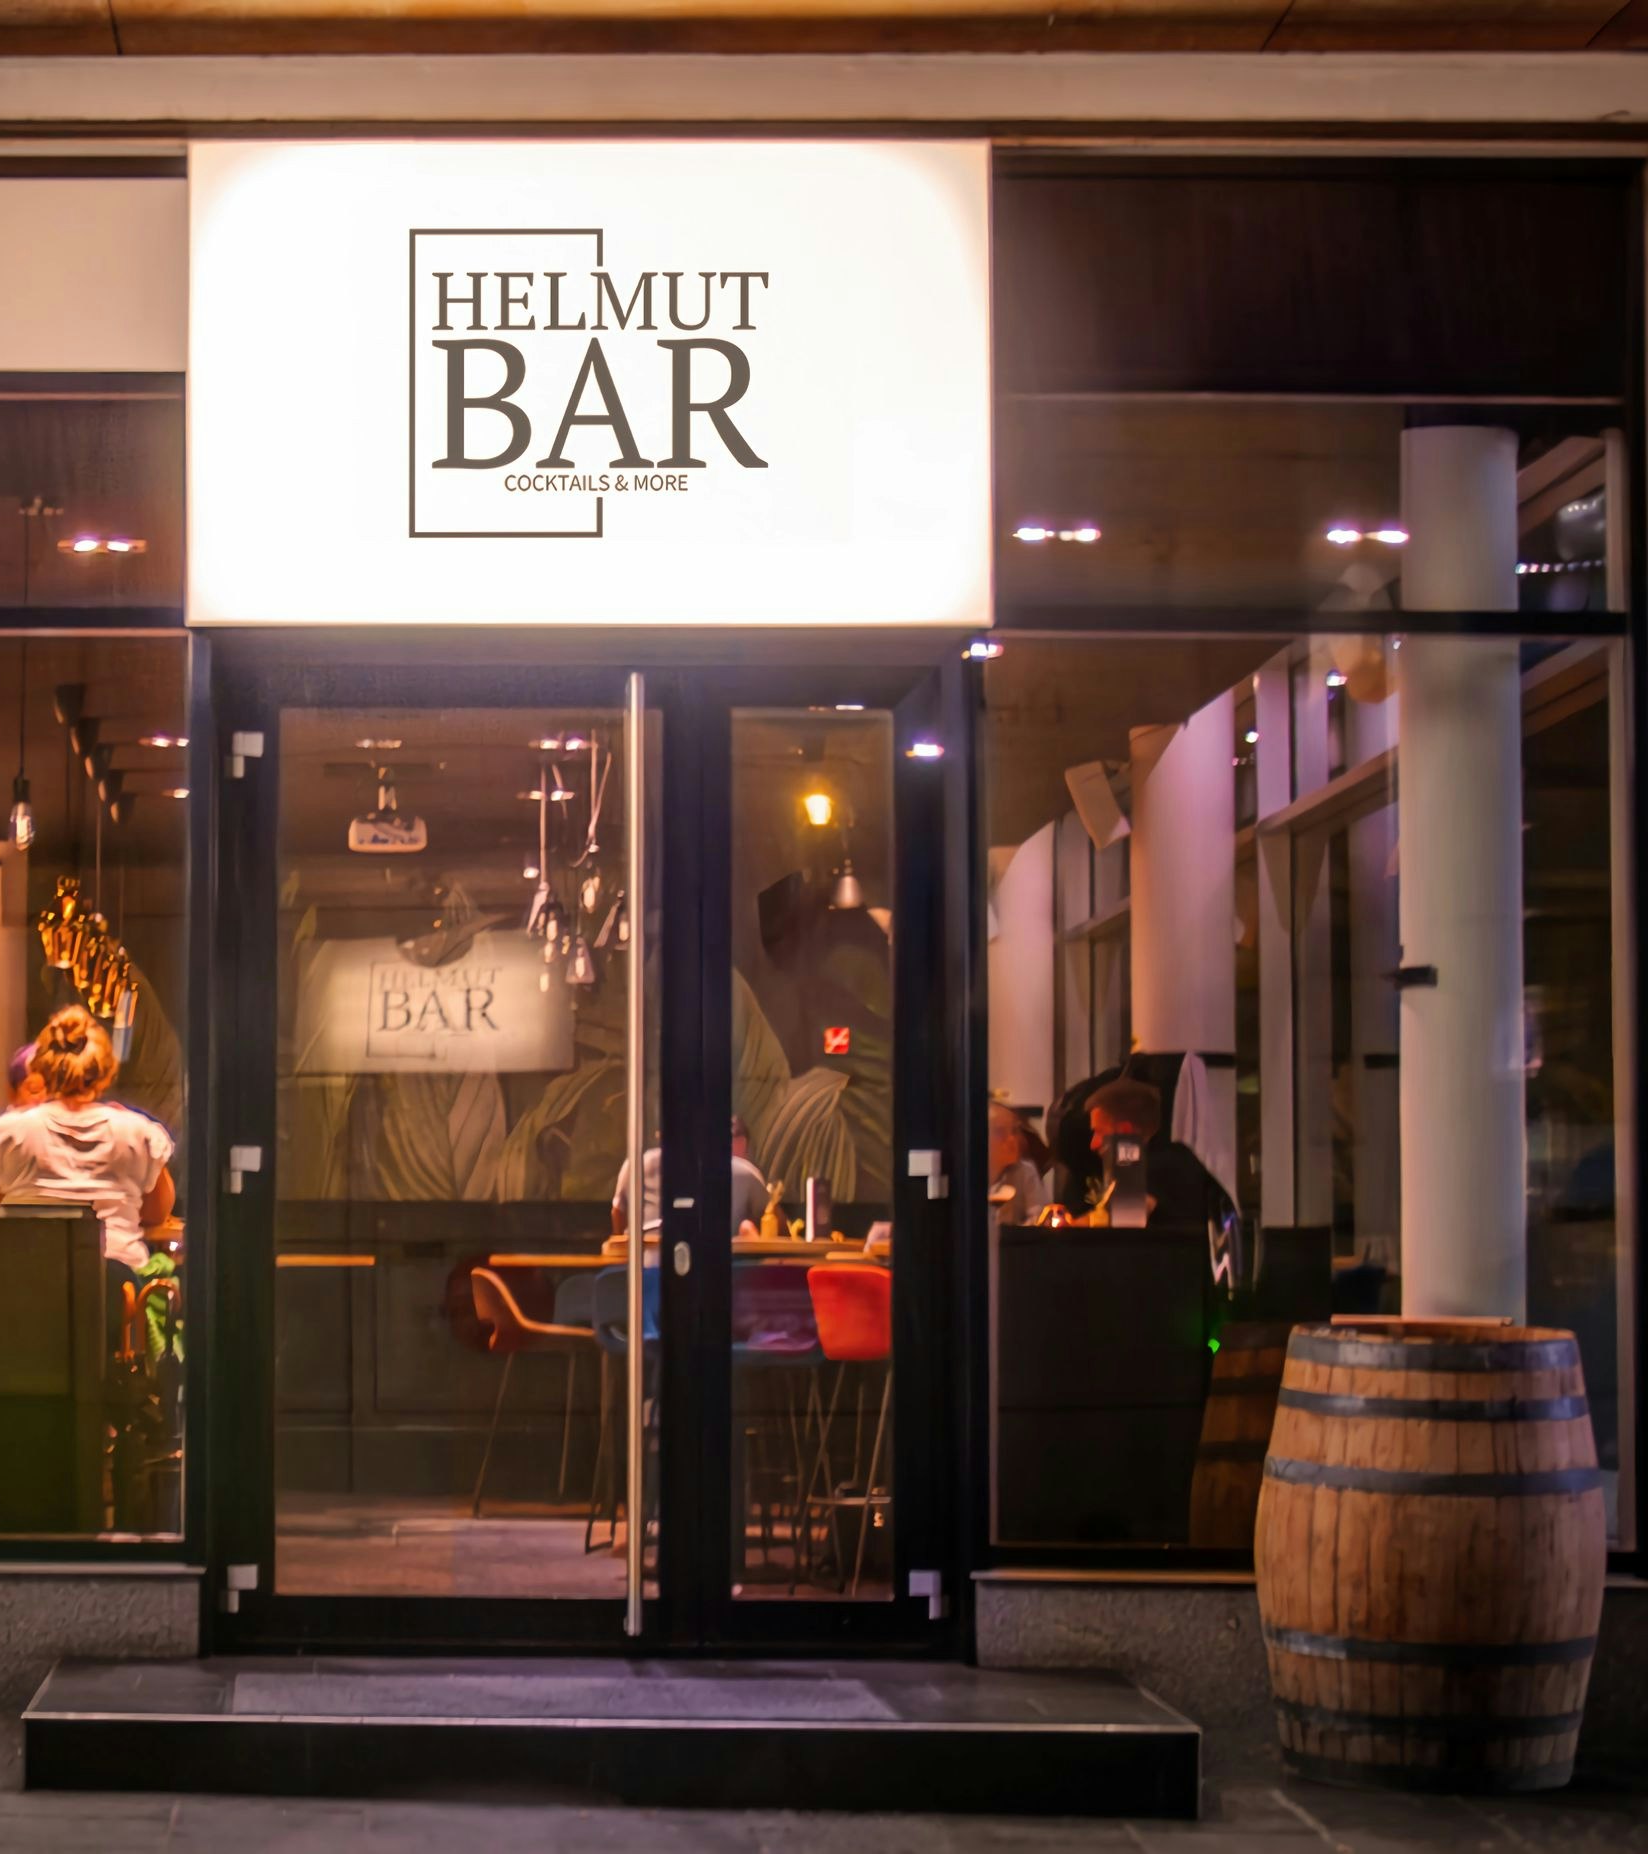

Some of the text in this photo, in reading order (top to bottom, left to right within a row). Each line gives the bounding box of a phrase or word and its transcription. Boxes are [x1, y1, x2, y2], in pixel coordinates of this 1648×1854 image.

[432, 272, 769, 331] HELMUT
[432, 337, 769, 470] BAR
[504, 474, 689, 492] COCKTAILS & MORE
[376, 986, 500, 1033] BAR
